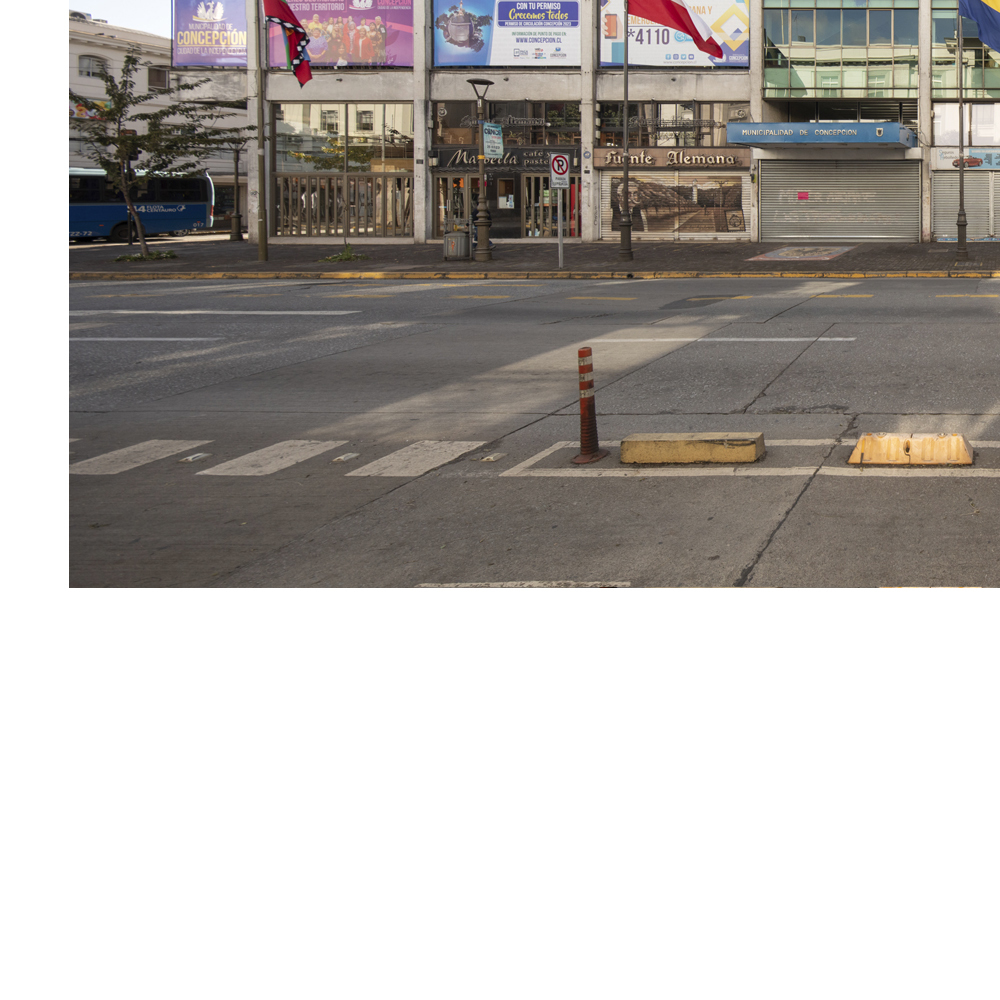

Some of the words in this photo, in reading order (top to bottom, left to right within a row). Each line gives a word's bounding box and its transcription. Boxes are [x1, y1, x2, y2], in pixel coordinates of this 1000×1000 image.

[311, 3, 344, 11] TERRITORIO
[537, 2, 561, 10] PERMISO
[707, 6, 712, 14] Y
[509, 8, 545, 20] Crecemos
[546, 9, 568, 20] todos
[177, 28, 247, 45] CONCEPCIÓN
[605, 150, 653, 165] Funte
[667, 150, 736, 166] Alemana
